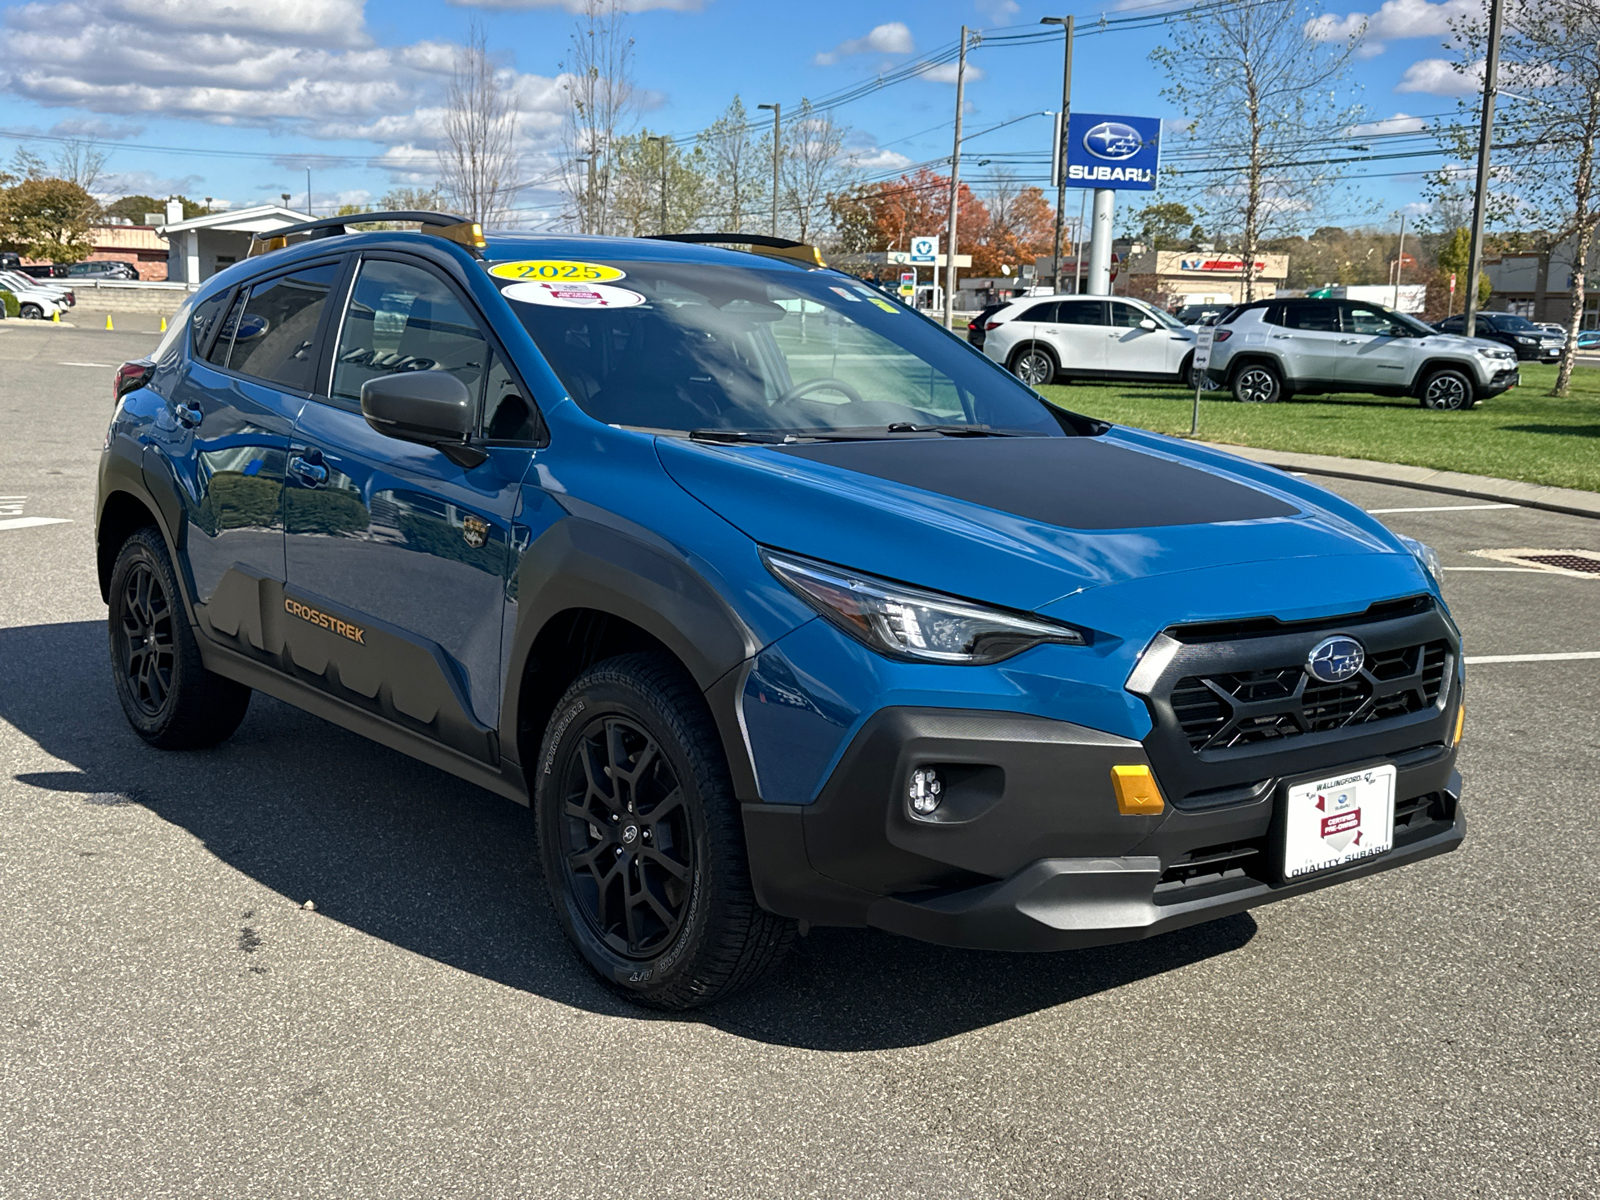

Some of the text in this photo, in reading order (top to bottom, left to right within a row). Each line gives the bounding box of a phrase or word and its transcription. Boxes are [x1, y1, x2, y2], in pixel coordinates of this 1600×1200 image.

[1068, 165, 1151, 182] SUBARU
[516, 265, 602, 279] 2025
[284, 599, 366, 645] CROSSTREK
[544, 701, 586, 775] YOKOHAMA
[1324, 819, 1359, 834] PRE-OWNED
[1327, 813, 1356, 826] CERTIFIED
[1291, 844, 1389, 878] QUALITY SUBARU
